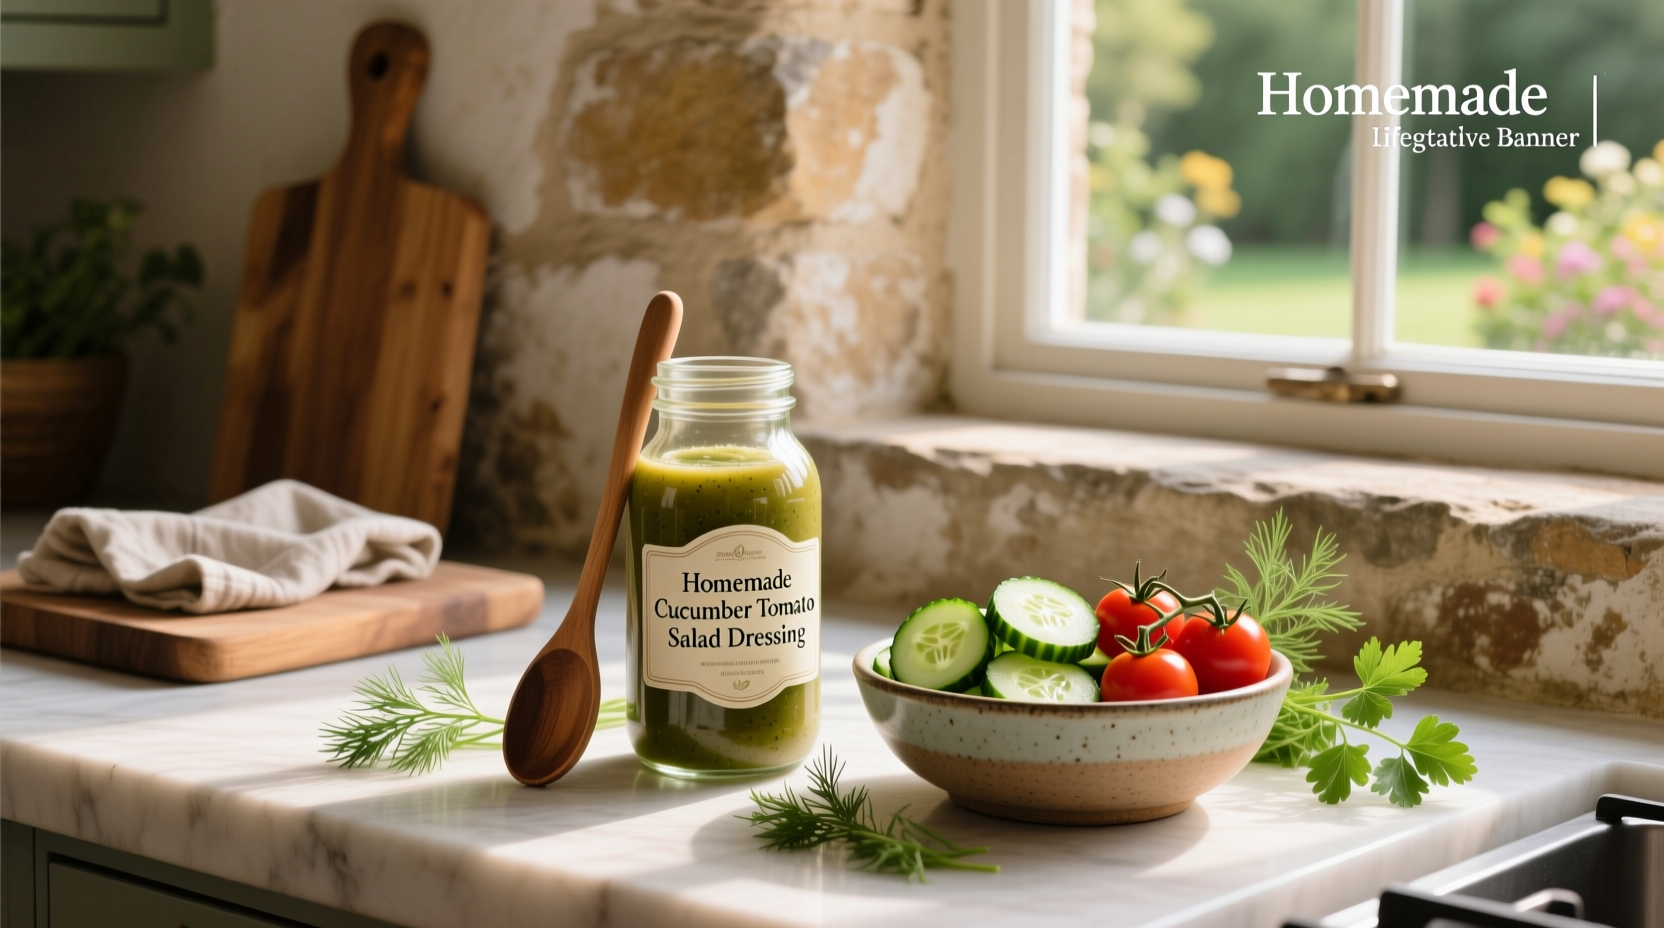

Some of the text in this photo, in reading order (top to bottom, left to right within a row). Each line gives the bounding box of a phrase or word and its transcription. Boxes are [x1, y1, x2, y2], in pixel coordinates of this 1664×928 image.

[682, 568, 792, 593] Homemade
[654, 596, 815, 620] Cucumber Tomato
[668, 624, 806, 649] Salad Dressing
